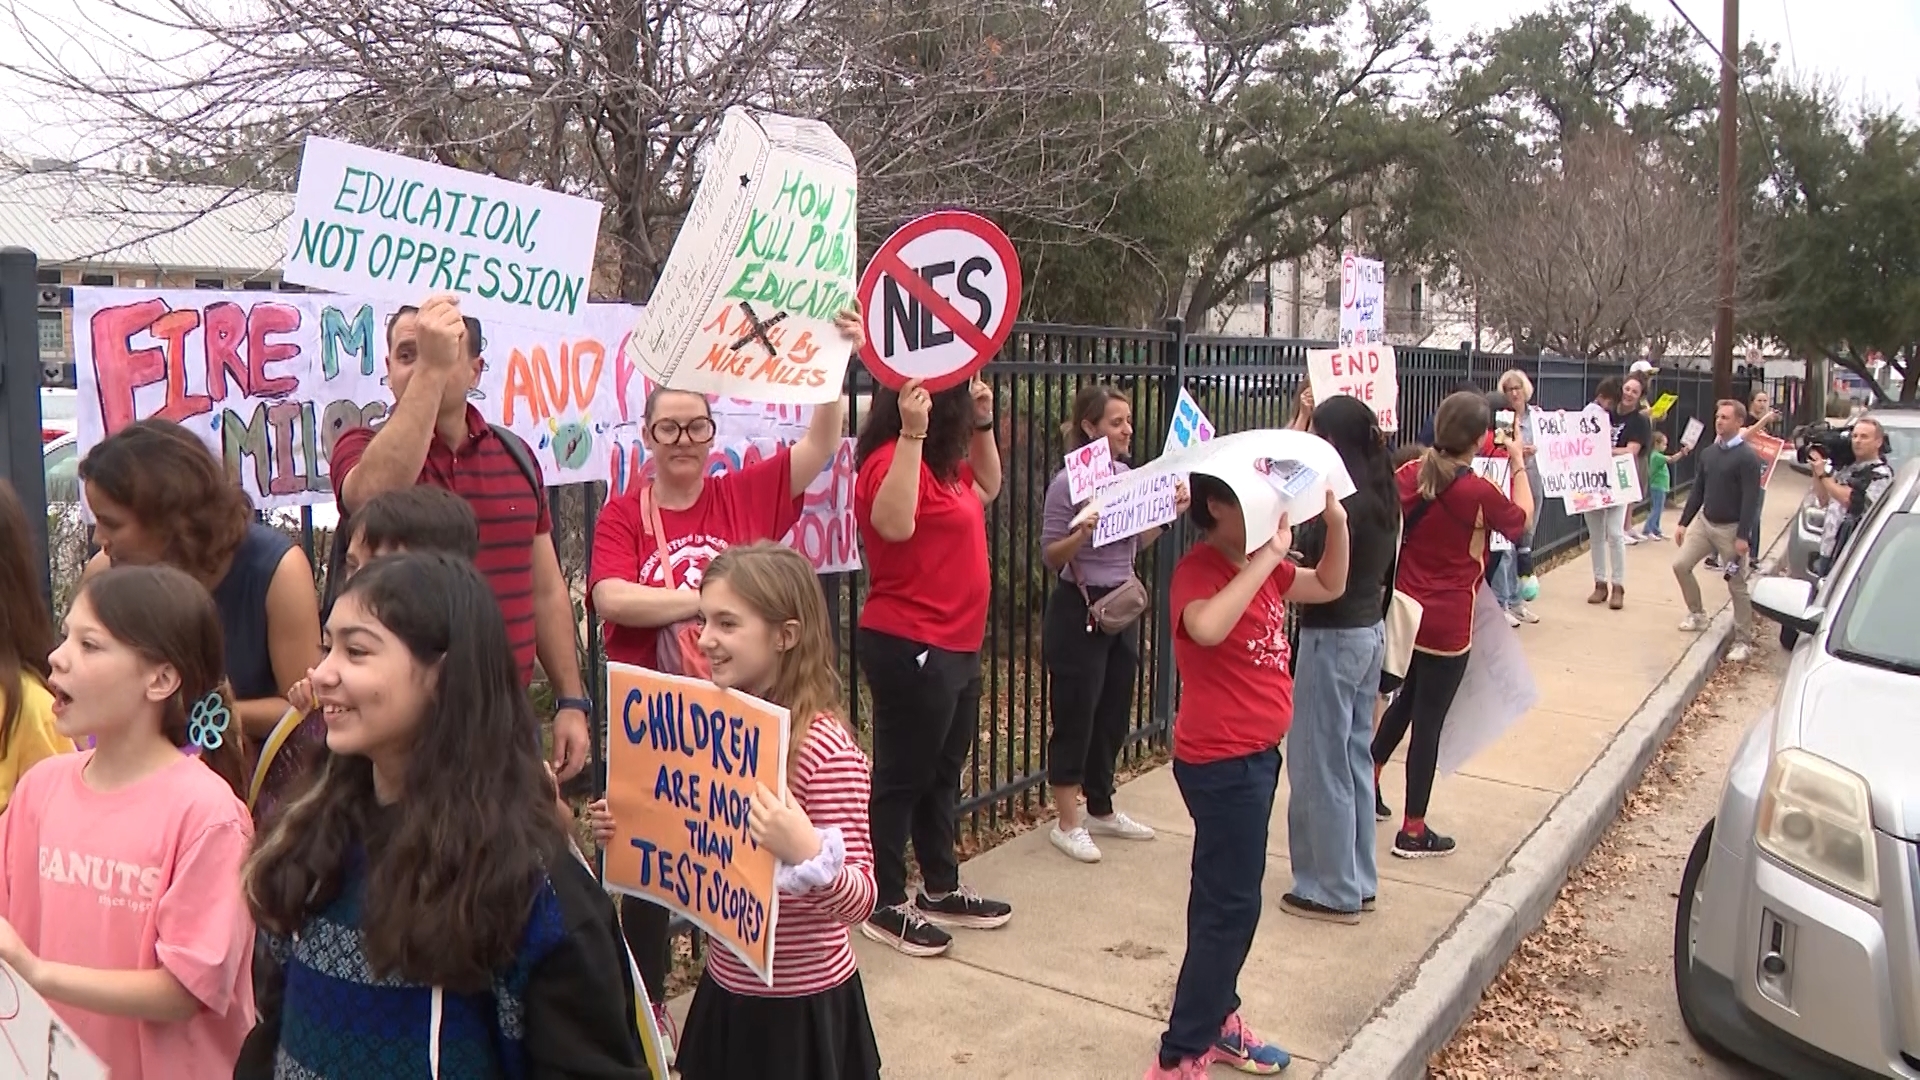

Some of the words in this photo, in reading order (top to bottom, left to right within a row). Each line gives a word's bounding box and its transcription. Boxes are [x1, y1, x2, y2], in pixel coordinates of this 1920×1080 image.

[334, 167, 541, 253] EDUCATION,
[772, 170, 835, 221] HOW
[840, 187, 857, 230] T
[291, 217, 364, 272] NOT
[368, 233, 584, 315] OPPRESSION
[736, 207, 796, 263] KILL
[796, 224, 856, 279] PUBLI
[703, 303, 732, 335] A
[723, 262, 852, 323] EDUCATIO
[882, 256, 993, 358] NES
[90, 297, 302, 438] FIRE
[503, 338, 605, 428] AND
[696, 343, 754, 376] MIKE
[749, 356, 828, 387] MILES
[1331, 352, 1379, 376] END
[1340, 382, 1374, 400] THE
[1543, 473, 1567, 492] UBLIC
[623, 688, 759, 777] CHILDREN
[655, 764, 701, 813] ARE
[709, 780, 757, 850] MOR
[39, 846, 161, 899] EANUTS
[685, 819, 733, 869] THAN
[631, 838, 707, 912] TEST
[707, 870, 764, 945] SCORES
